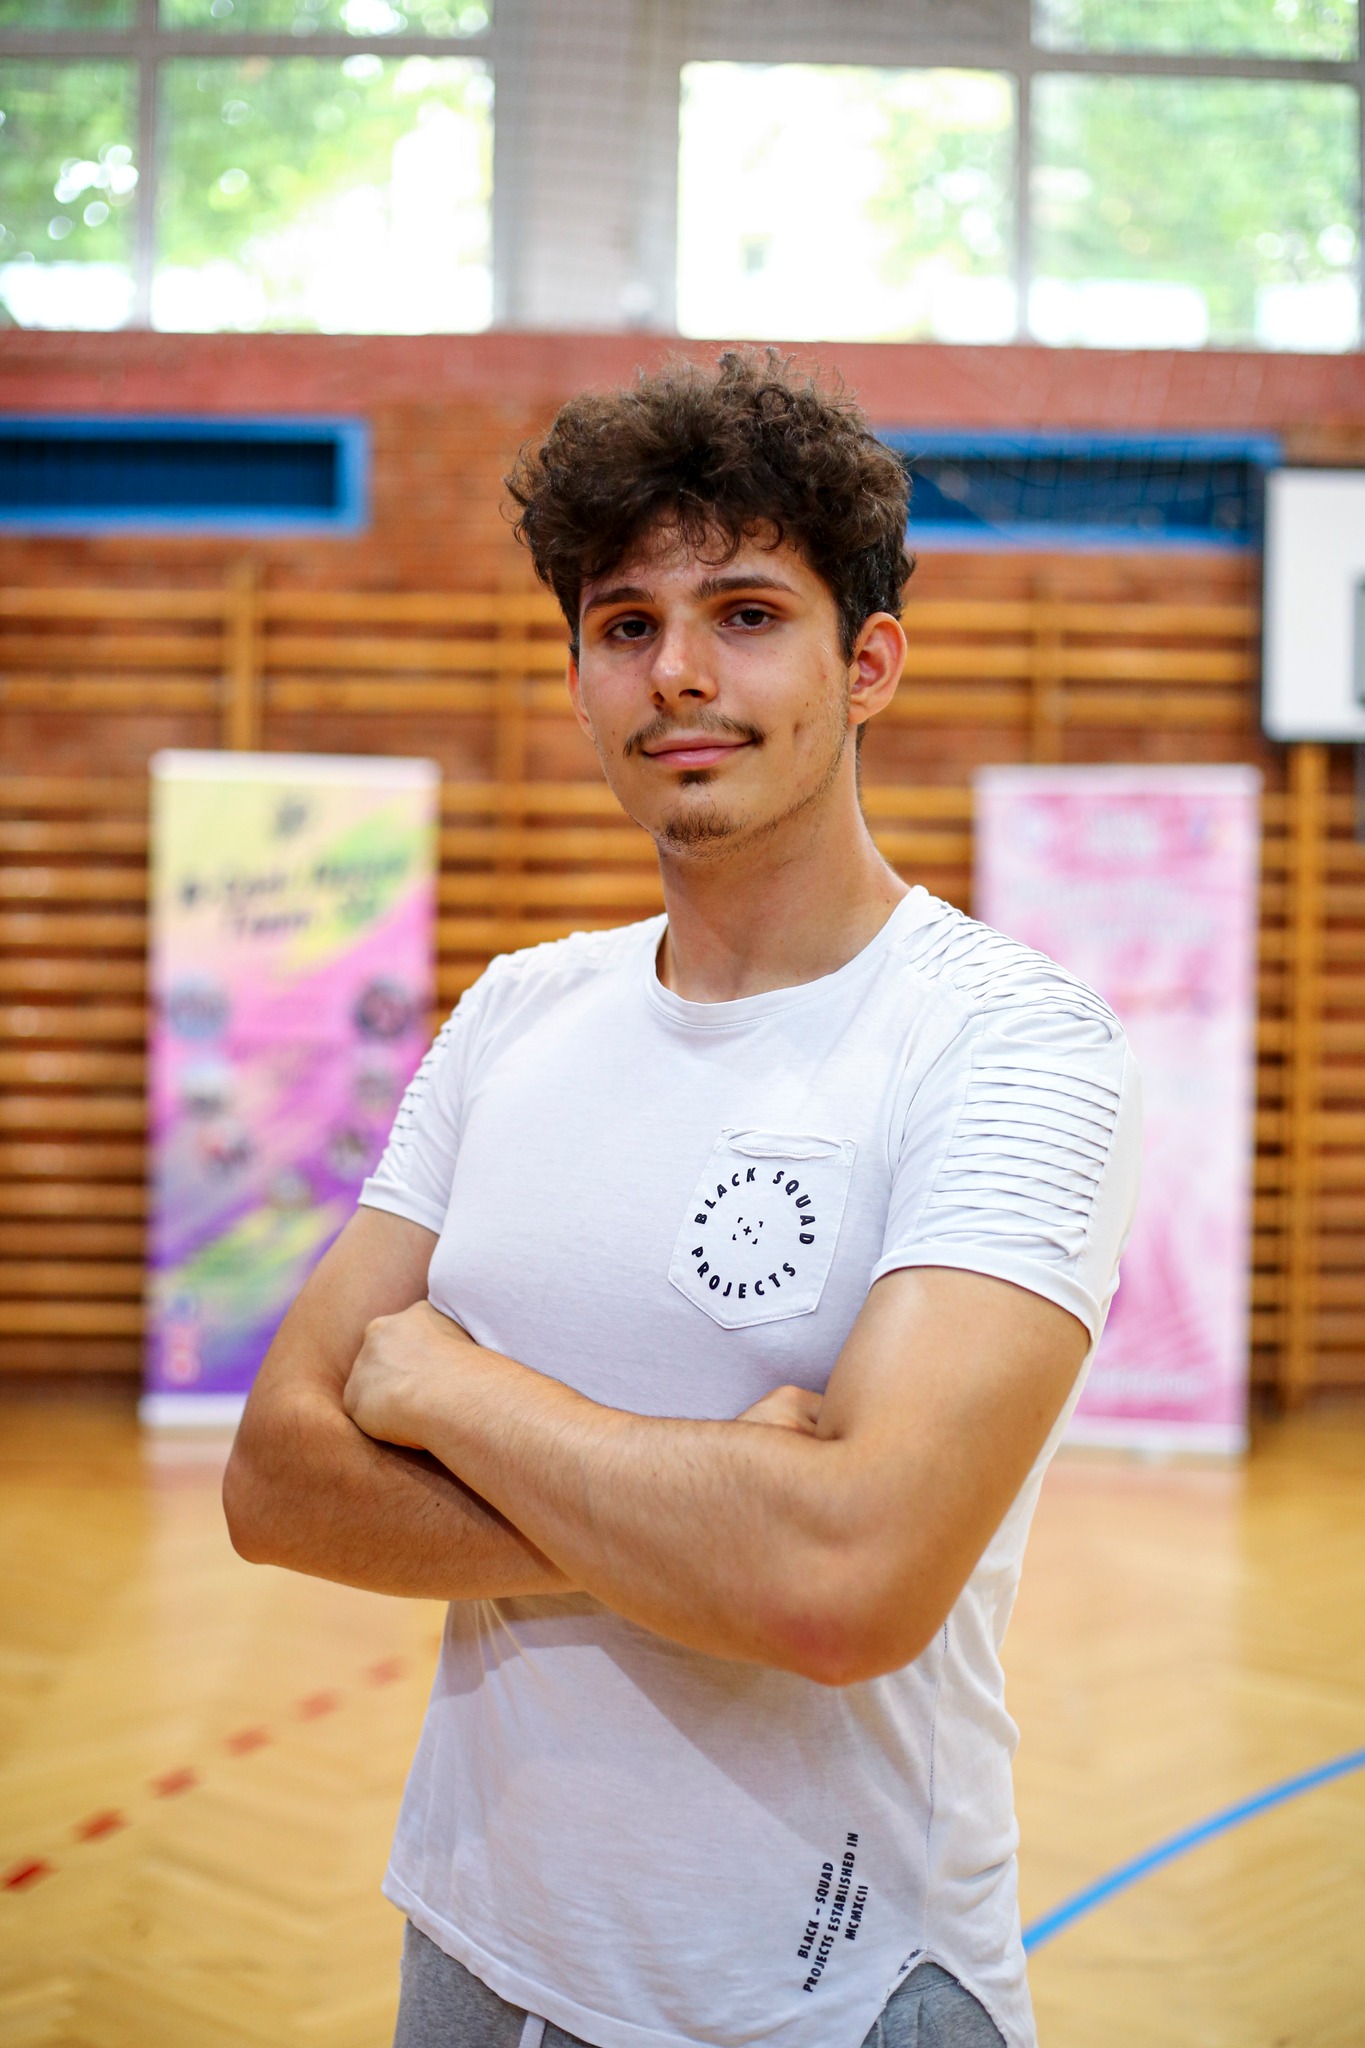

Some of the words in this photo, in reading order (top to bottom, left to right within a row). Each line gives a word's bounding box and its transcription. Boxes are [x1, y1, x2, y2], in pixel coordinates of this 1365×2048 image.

[694, 1167, 756, 1225] BLACK
[772, 1170, 816, 1245] SQUAD
[691, 1246, 796, 1299] PROJECTS
[797, 1919, 820, 1959] BLACK
[814, 1862, 834, 1905] SQUAD
[802, 1934, 835, 1993] PROJECTS
[827, 1851, 856, 1932] ESTABLISHED
[846, 1832, 859, 1848] IN
[844, 1885, 869, 1941] MCMXCII
